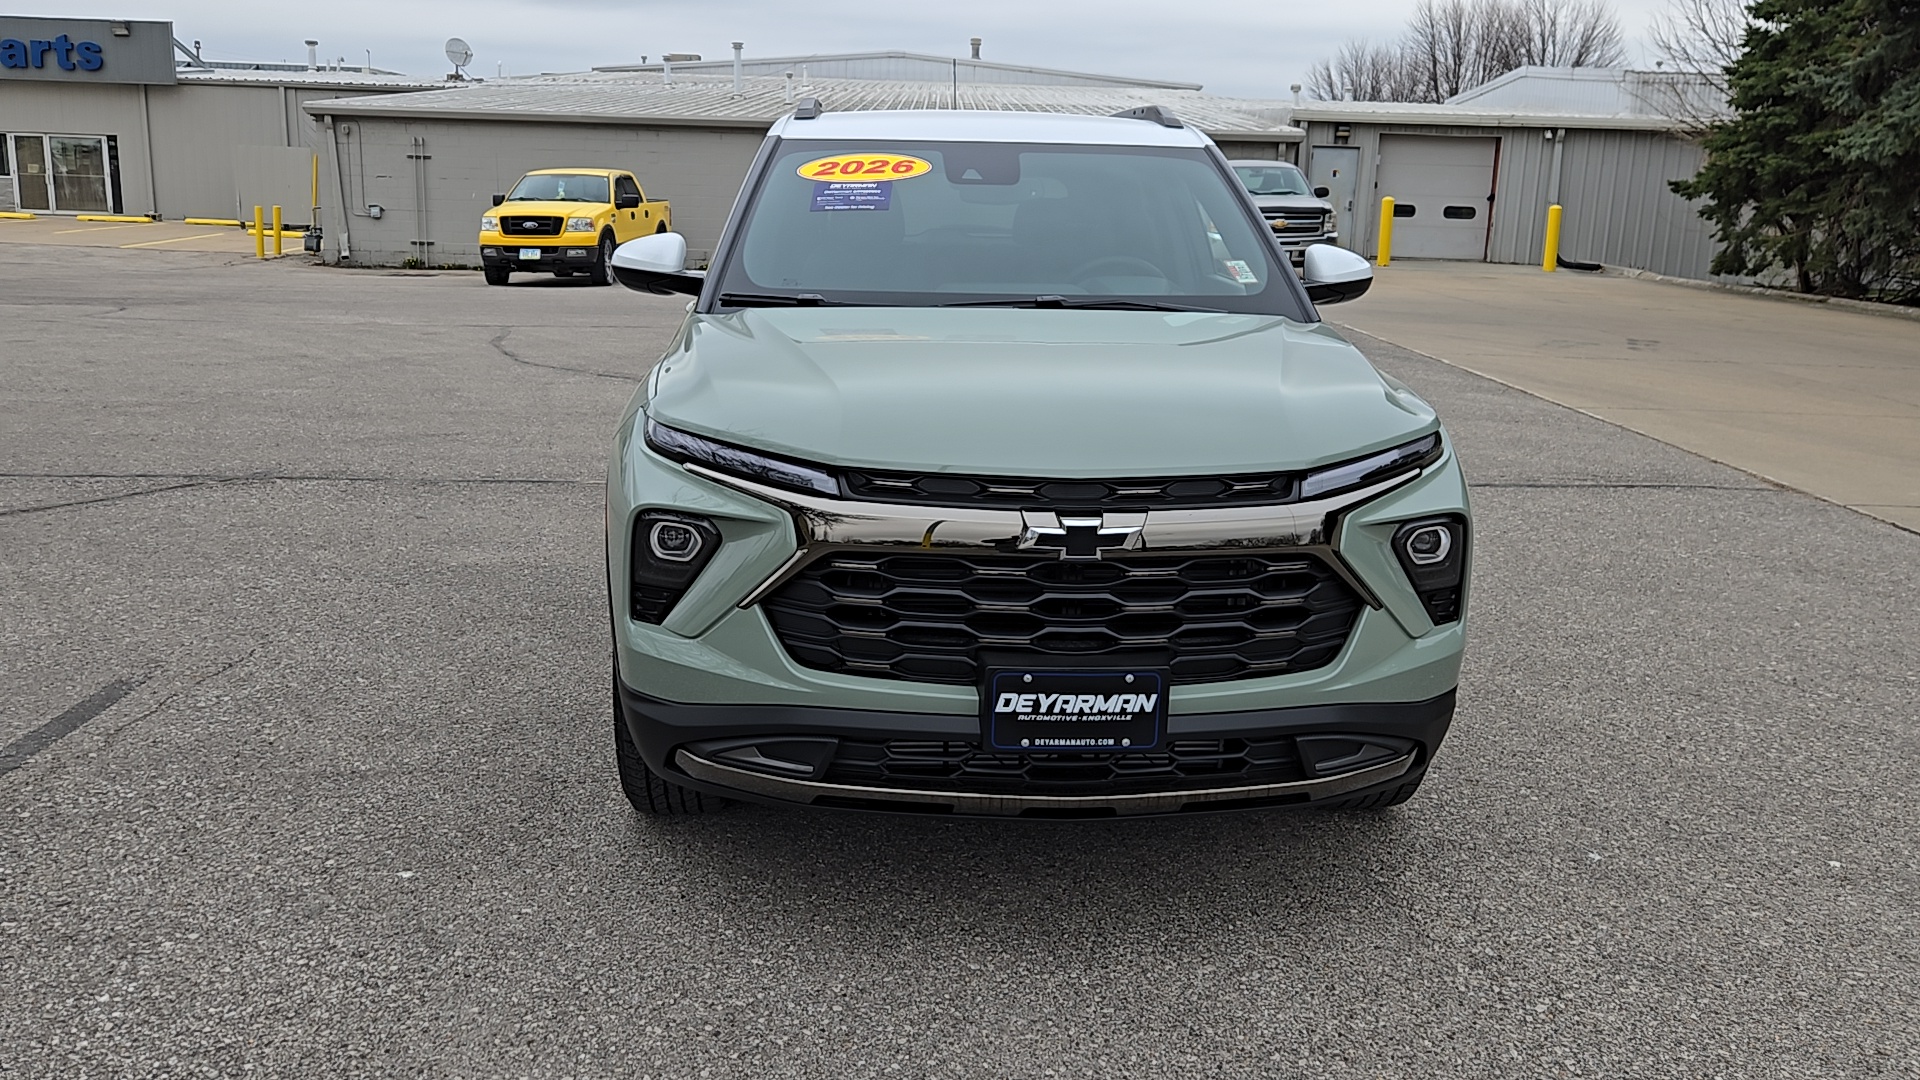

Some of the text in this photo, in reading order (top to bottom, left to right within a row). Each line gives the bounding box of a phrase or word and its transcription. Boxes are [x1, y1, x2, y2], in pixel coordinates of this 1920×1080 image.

[812, 160, 917, 176] 2026
[994, 693, 1158, 713] DEYARMAN
[1034, 738, 1115, 746] DEYARMANAUTO.COM
